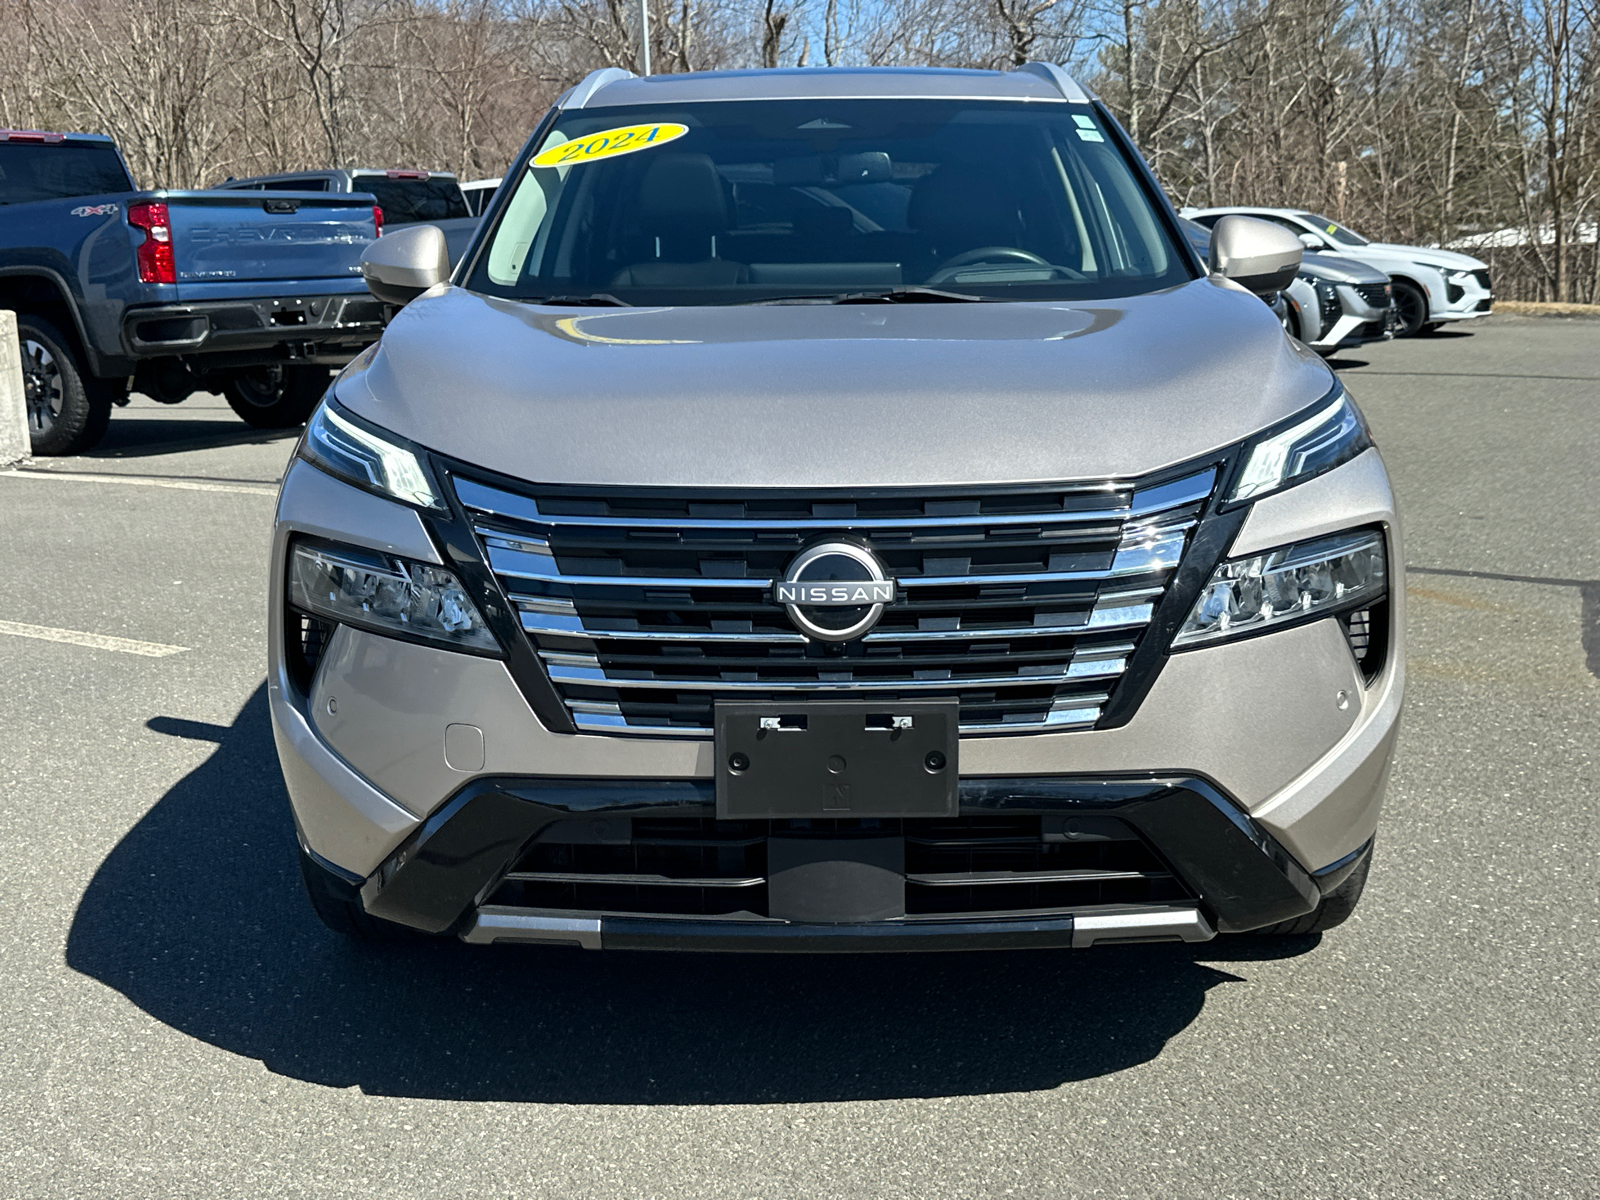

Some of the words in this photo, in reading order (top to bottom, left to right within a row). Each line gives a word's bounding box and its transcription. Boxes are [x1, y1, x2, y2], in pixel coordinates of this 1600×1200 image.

[557, 127, 660, 163] 2024
[190, 226, 365, 243] CHEVRO
[779, 586, 891, 602] NISSAN
